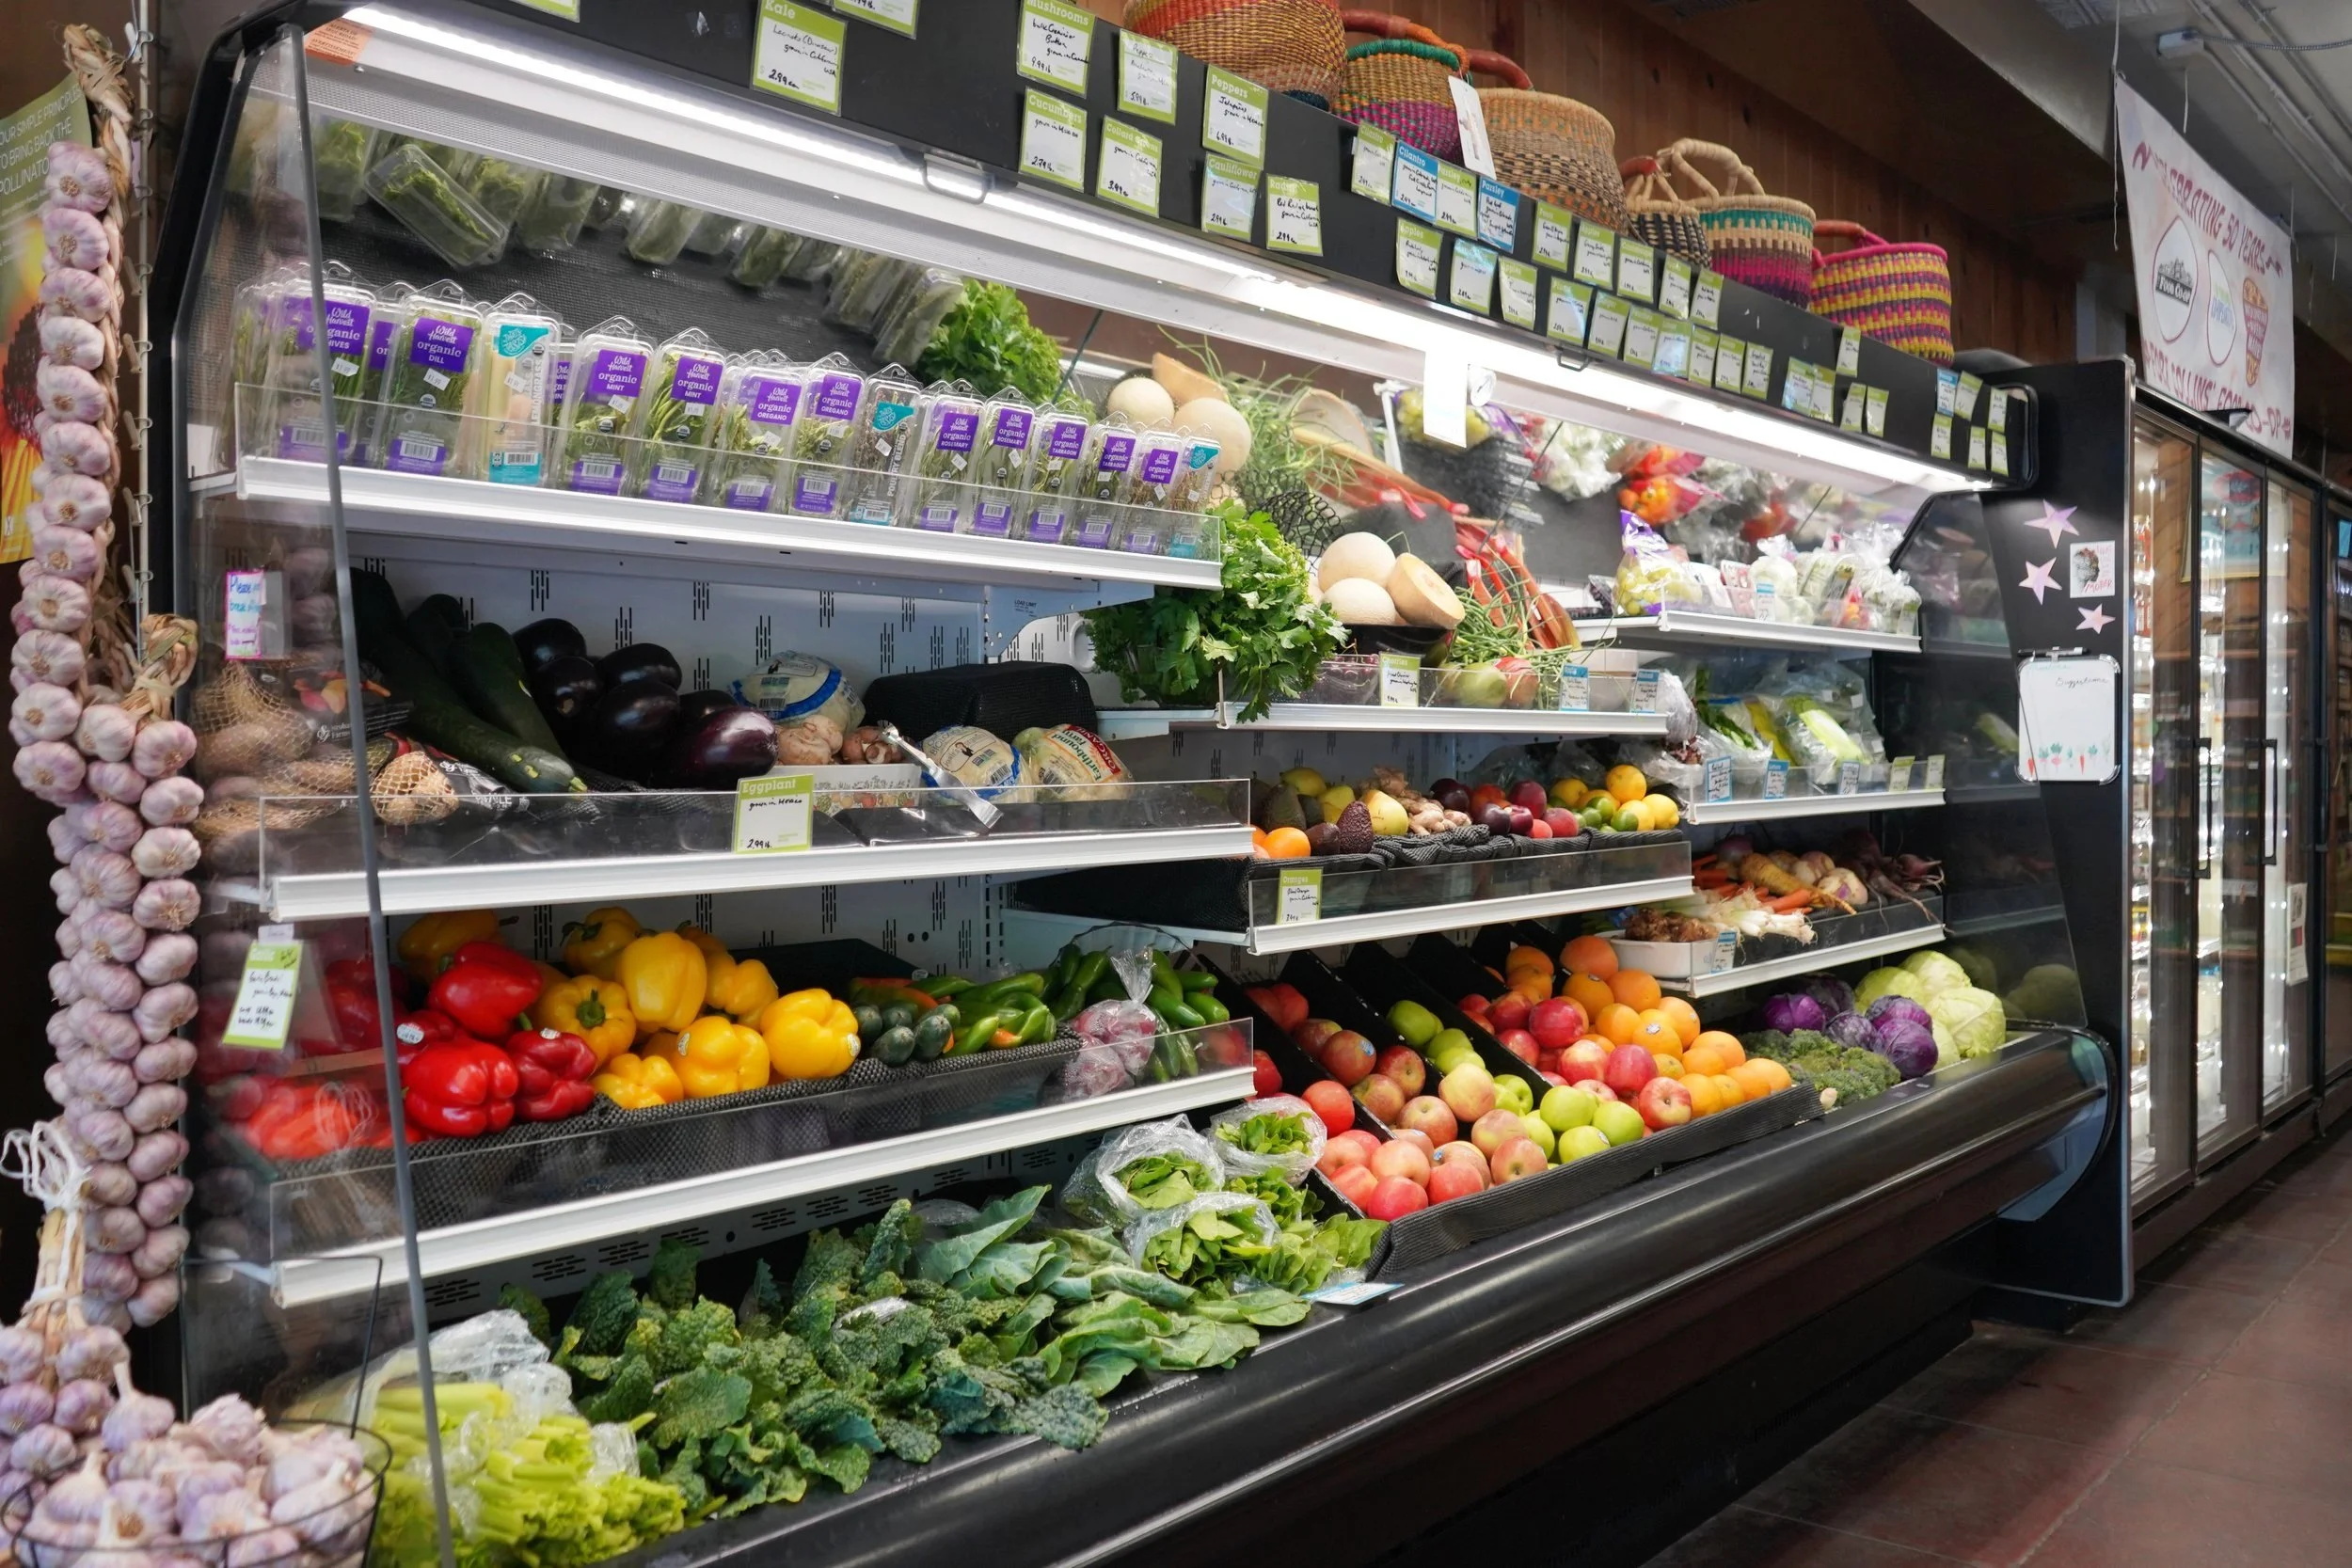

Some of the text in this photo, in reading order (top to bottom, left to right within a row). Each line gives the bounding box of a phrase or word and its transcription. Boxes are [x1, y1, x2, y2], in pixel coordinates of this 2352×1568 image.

[764, 0, 796, 19] Kale
[1212, 74, 1248, 99] Peppers
[17, 110, 43, 137] SIMPLE
[43, 86, 82, 118] PRINCIPLES
[9, 143, 34, 166] BRING
[34, 127, 56, 152] BACK
[56, 117, 73, 140] THE
[1399, 146, 1426, 166] Cilantro
[1208, 159, 1258, 181] Cauliflower
[0, 157, 50, 196] POLLINATO
[1482, 180, 1505, 198] Parsley
[2222, 213, 2240, 252] 50
[2238, 226, 2265, 276] YEARS
[436, 325, 456, 337] Wild
[417, 341, 462, 357] organic
[428, 355, 445, 364] DILL
[598, 372, 638, 384] organic
[606, 383, 626, 391] MINT
[677, 379, 714, 392] organic
[684, 390, 702, 399] MINT
[758, 403, 792, 414] organic
[821, 397, 852, 408] organic
[757, 411, 787, 421] OREGANO
[820, 405, 849, 416] OREGANO
[943, 432, 972, 441] organic
[998, 428, 1025, 439] organic
[894, 434, 907, 460] BLEND
[940, 439, 969, 449] ROSEMARY
[996, 436, 1024, 446] ROSEMARY
[1054, 439, 1080, 450] organic
[1104, 453, 1129, 463] organic
[1148, 466, 1171, 475] organic
[1052, 734, 1102, 782] Earthbound
[742, 779, 797, 796] Eggplant
